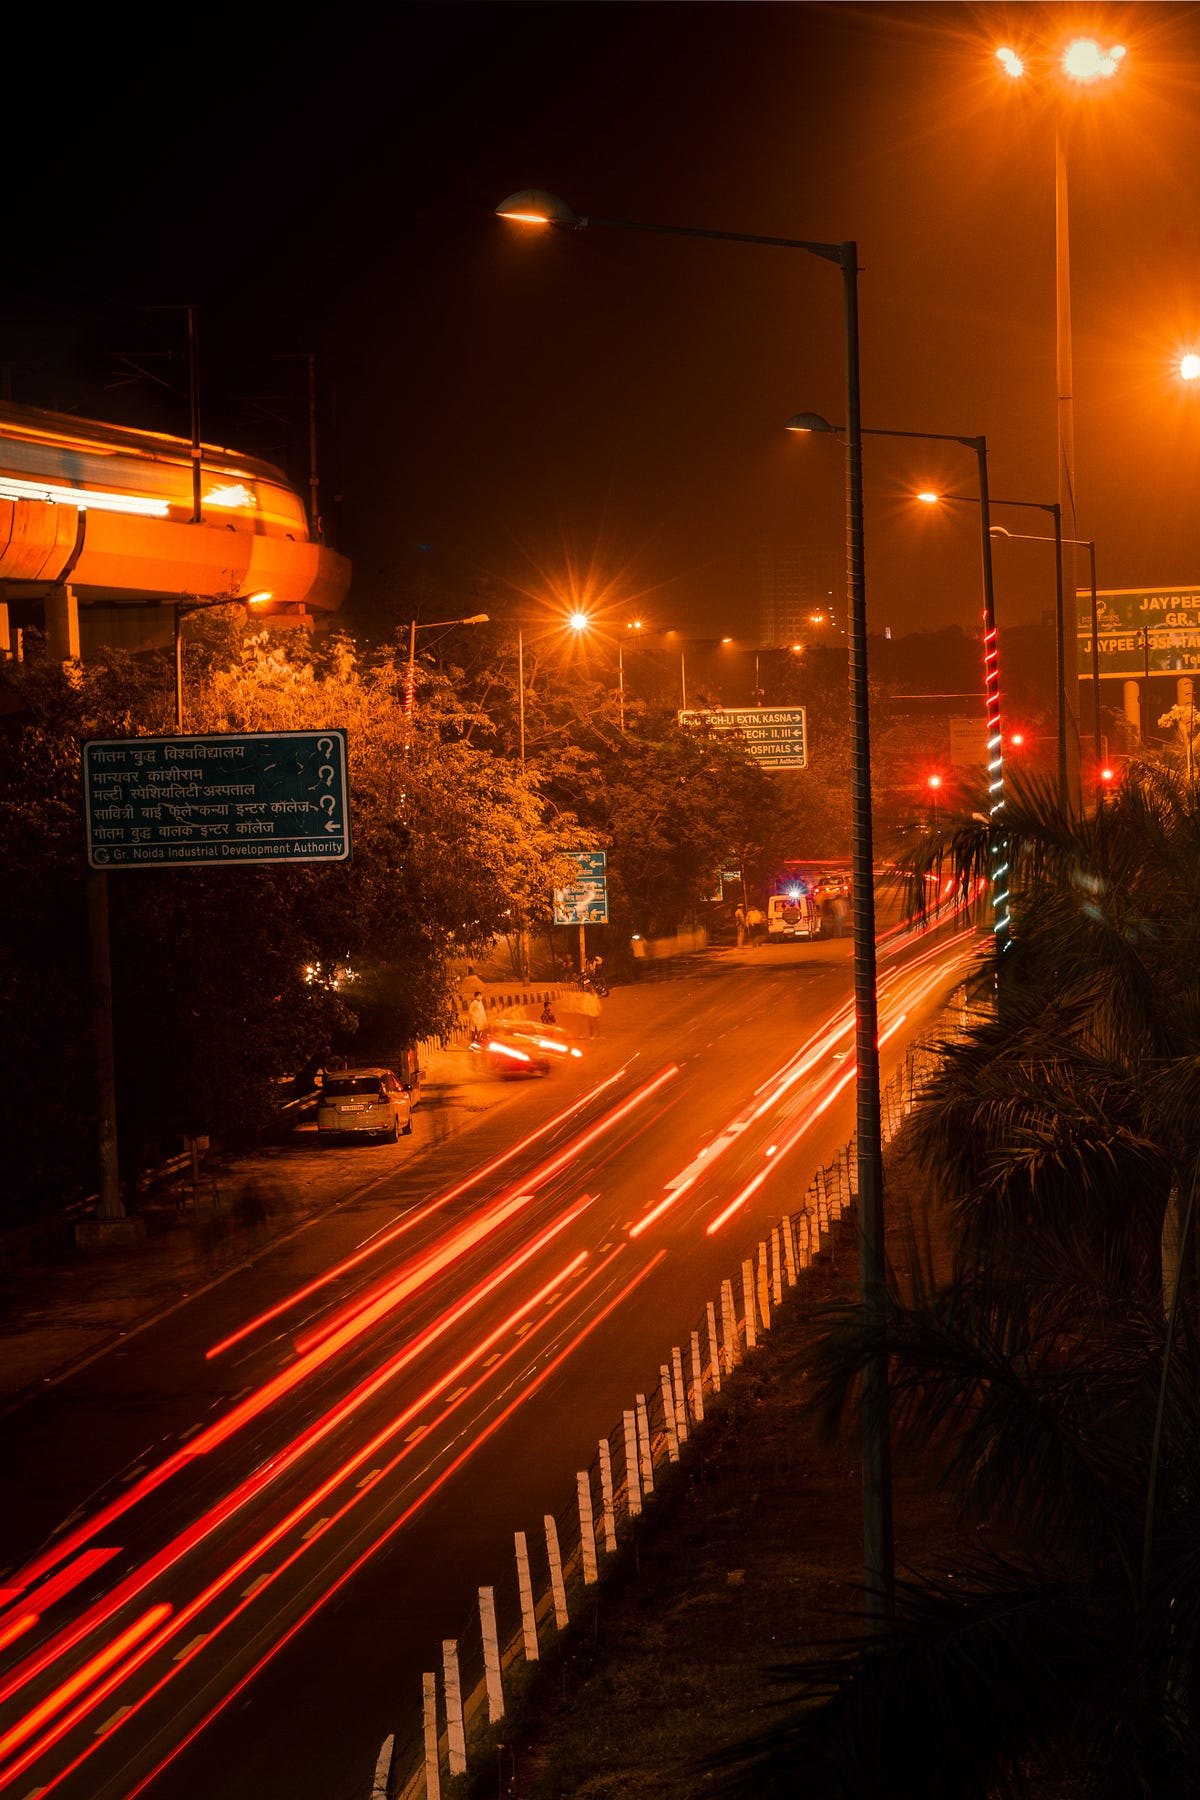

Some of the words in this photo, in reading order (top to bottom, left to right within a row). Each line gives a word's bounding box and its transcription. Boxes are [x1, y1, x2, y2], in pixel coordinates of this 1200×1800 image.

[1139, 595, 1200, 611] JAYPEE
[1165, 612, 1193, 626] GR.
[762, 713, 792, 723] KASNA
[163, 744, 245, 761] विश्वविद्यालय
[92, 771, 139, 784] मान्यवर
[92, 785, 123, 801] मल्टी
[203, 784, 256, 797] अस्पताल
[93, 803, 134, 820] सावित्री
[197, 804, 229, 816] कन्या
[236, 803, 265, 816] इन्टर
[270, 798, 310, 813] कॉलेज
[201, 824, 229, 838] इन्टर
[236, 819, 275, 834] कॉलेज
[133, 847, 164, 859] Noida
[168, 845, 218, 858] Industrial
[221, 842, 291, 856] Development
[293, 840, 343, 854] Authority
